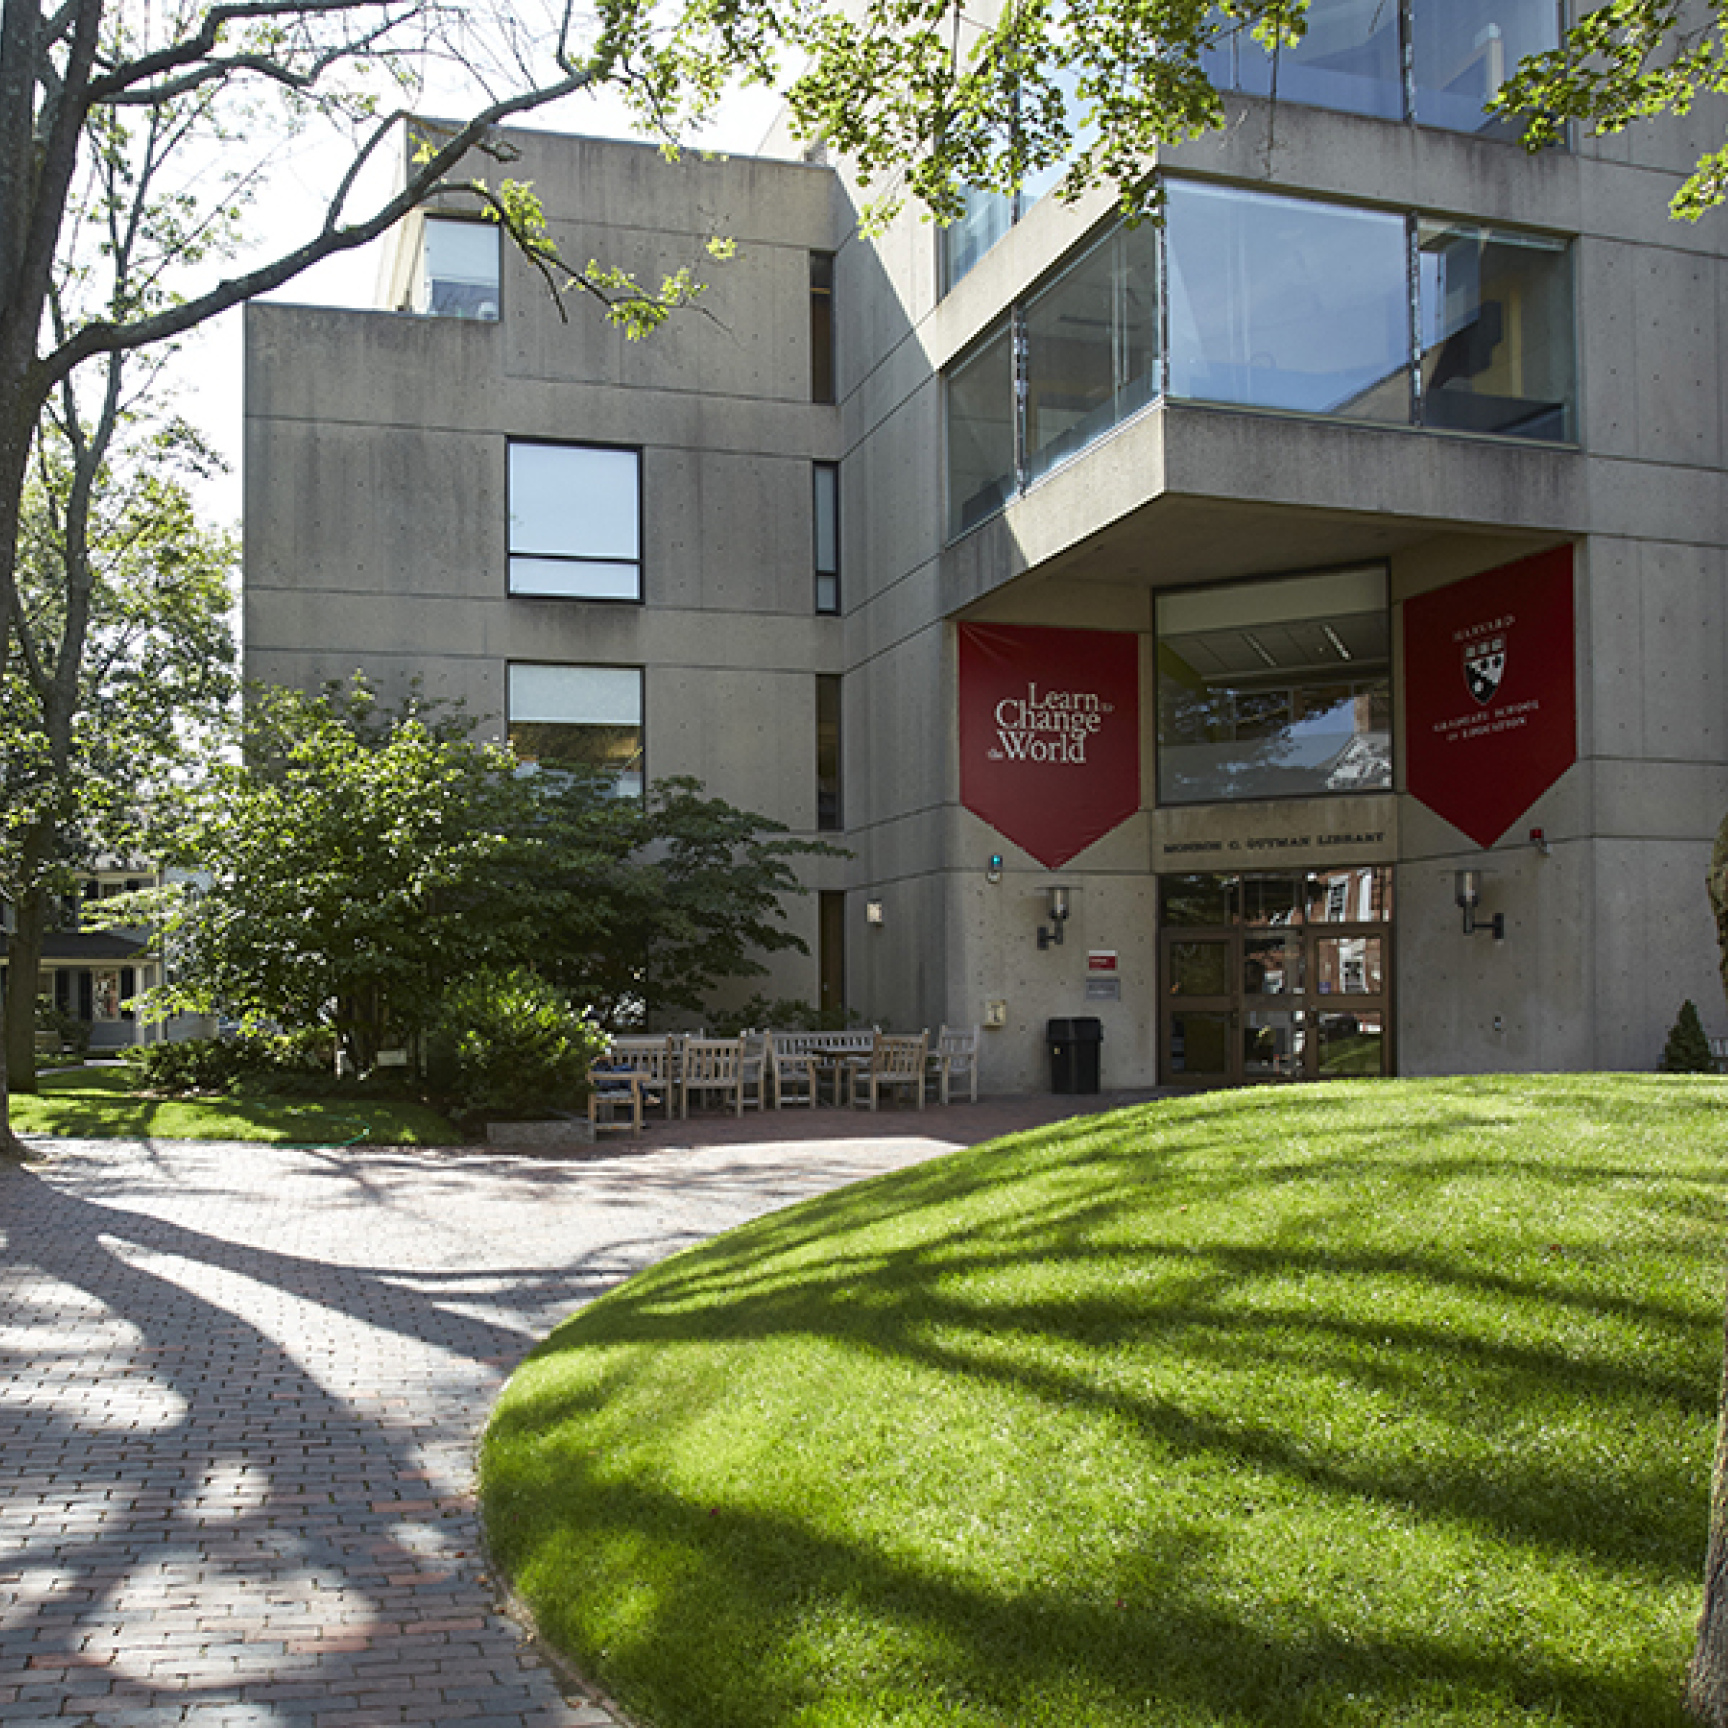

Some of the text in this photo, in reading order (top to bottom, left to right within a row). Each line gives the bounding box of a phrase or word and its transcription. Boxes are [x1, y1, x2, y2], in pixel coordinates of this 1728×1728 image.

[1029, 682, 1099, 711] Learn
[994, 698, 1101, 739] Change
[997, 731, 1086, 763] World
